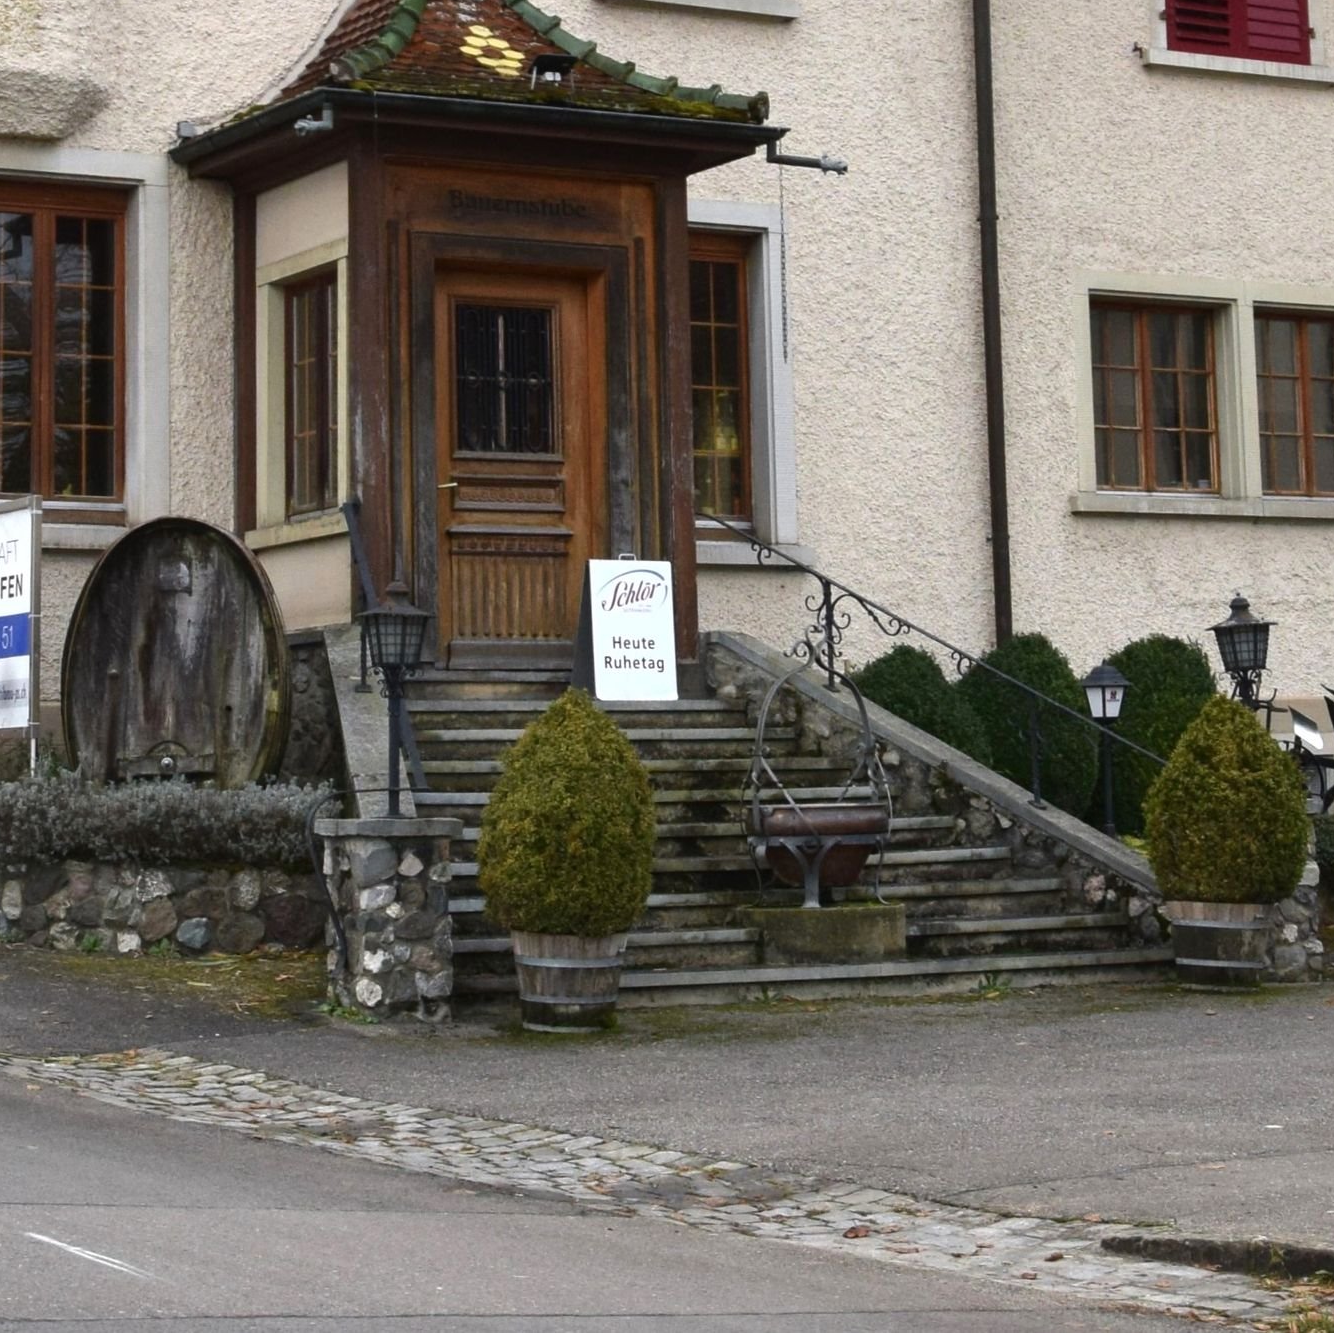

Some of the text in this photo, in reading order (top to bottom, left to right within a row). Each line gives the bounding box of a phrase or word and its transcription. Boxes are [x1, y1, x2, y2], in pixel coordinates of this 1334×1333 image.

[2, 625, 13, 649] 51
[612, 636, 656, 650] Heute
[604, 655, 665, 672] Ruhetag
